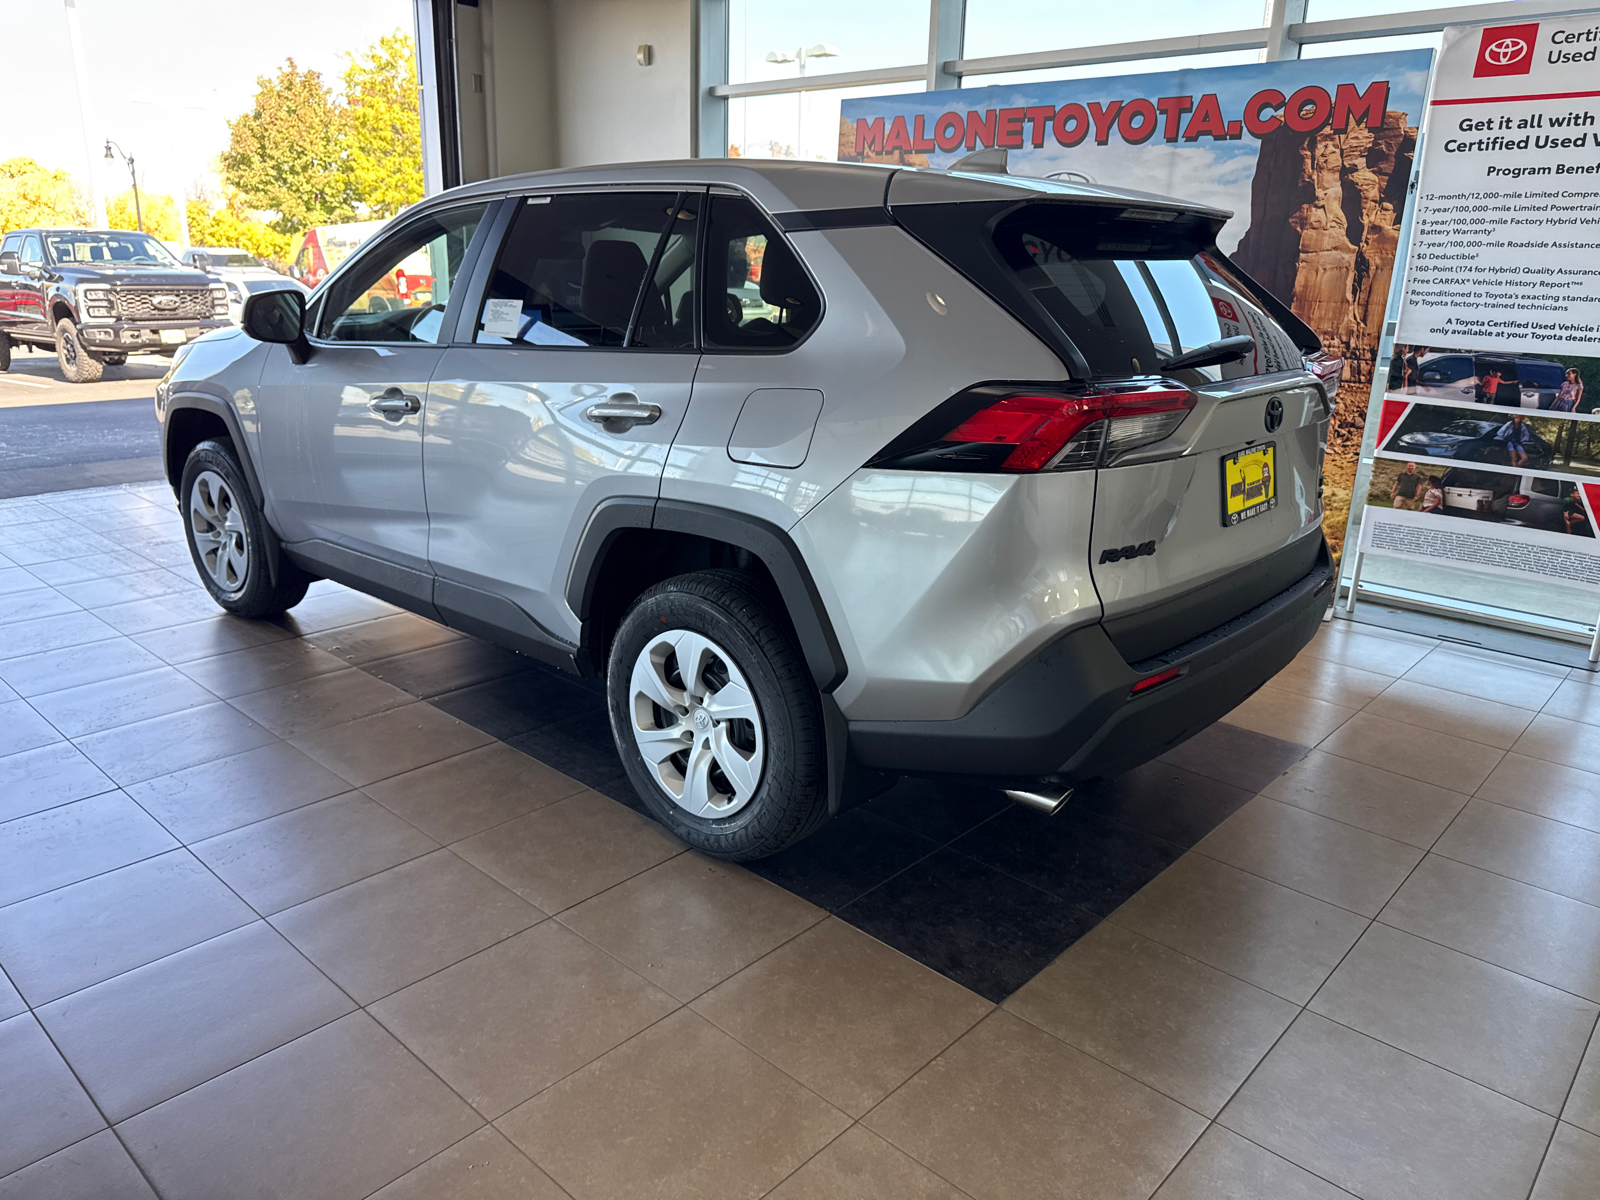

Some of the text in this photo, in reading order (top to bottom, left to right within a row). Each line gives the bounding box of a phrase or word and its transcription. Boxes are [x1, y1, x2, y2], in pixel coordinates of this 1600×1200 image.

[1551, 26, 1600, 45] Certi
[1547, 46, 1597, 64] Used
[855, 80, 1390, 155] MALONETOYOTA.COM
[1458, 111, 1595, 132] Get it all with
[1443, 134, 1530, 153] Certified
[1534, 132, 1588, 149] Used
[1486, 163, 1552, 179] Program
[1425, 190, 1600, 202] 12-month/12,000-mile Limited Compre
[1423, 204, 1512, 215] 7-year/100,000-mile
[1513, 204, 1549, 213] Limited
[1421, 217, 1509, 227] 8-year/100,000-mile
[1510, 217, 1544, 227] Factory
[1545, 217, 1578, 227] Hybrid
[1420, 228, 1451, 237] Battery
[1418, 240, 1506, 250] 7-year/100,000-mile
[1507, 240, 1549, 249] Roadside
[1415, 265, 1454, 274] 160-Point
[1455, 265, 1473, 275] (174
[1474, 265, 1487, 274] for
[1488, 266, 1521, 276] Hybrid)
[1522, 267, 1556, 276] Quality
[1412, 277, 1431, 285] Free
[1472, 278, 1503, 287] Vehicle
[1504, 279, 1538, 289] History
[1410, 289, 1472, 299] Reconditioned
[1473, 291, 1483, 299] to
[1520, 293, 1560, 303] exacting
[1409, 298, 1569, 312] by Toyota factory-trained technicians
[1445, 317, 1453, 326] A
[1454, 318, 1486, 328] Toyota
[1486, 319, 1529, 330] Certified
[1530, 321, 1557, 331] Used
[1558, 323, 1595, 333] Vehicle
[1429, 326, 1449, 336] only
[1450, 327, 1494, 338] available
[1494, 329, 1505, 338] at
[1505, 332, 1529, 341] your
[1530, 331, 1563, 342] Toyota
[1099, 540, 1156, 565] RAV4
